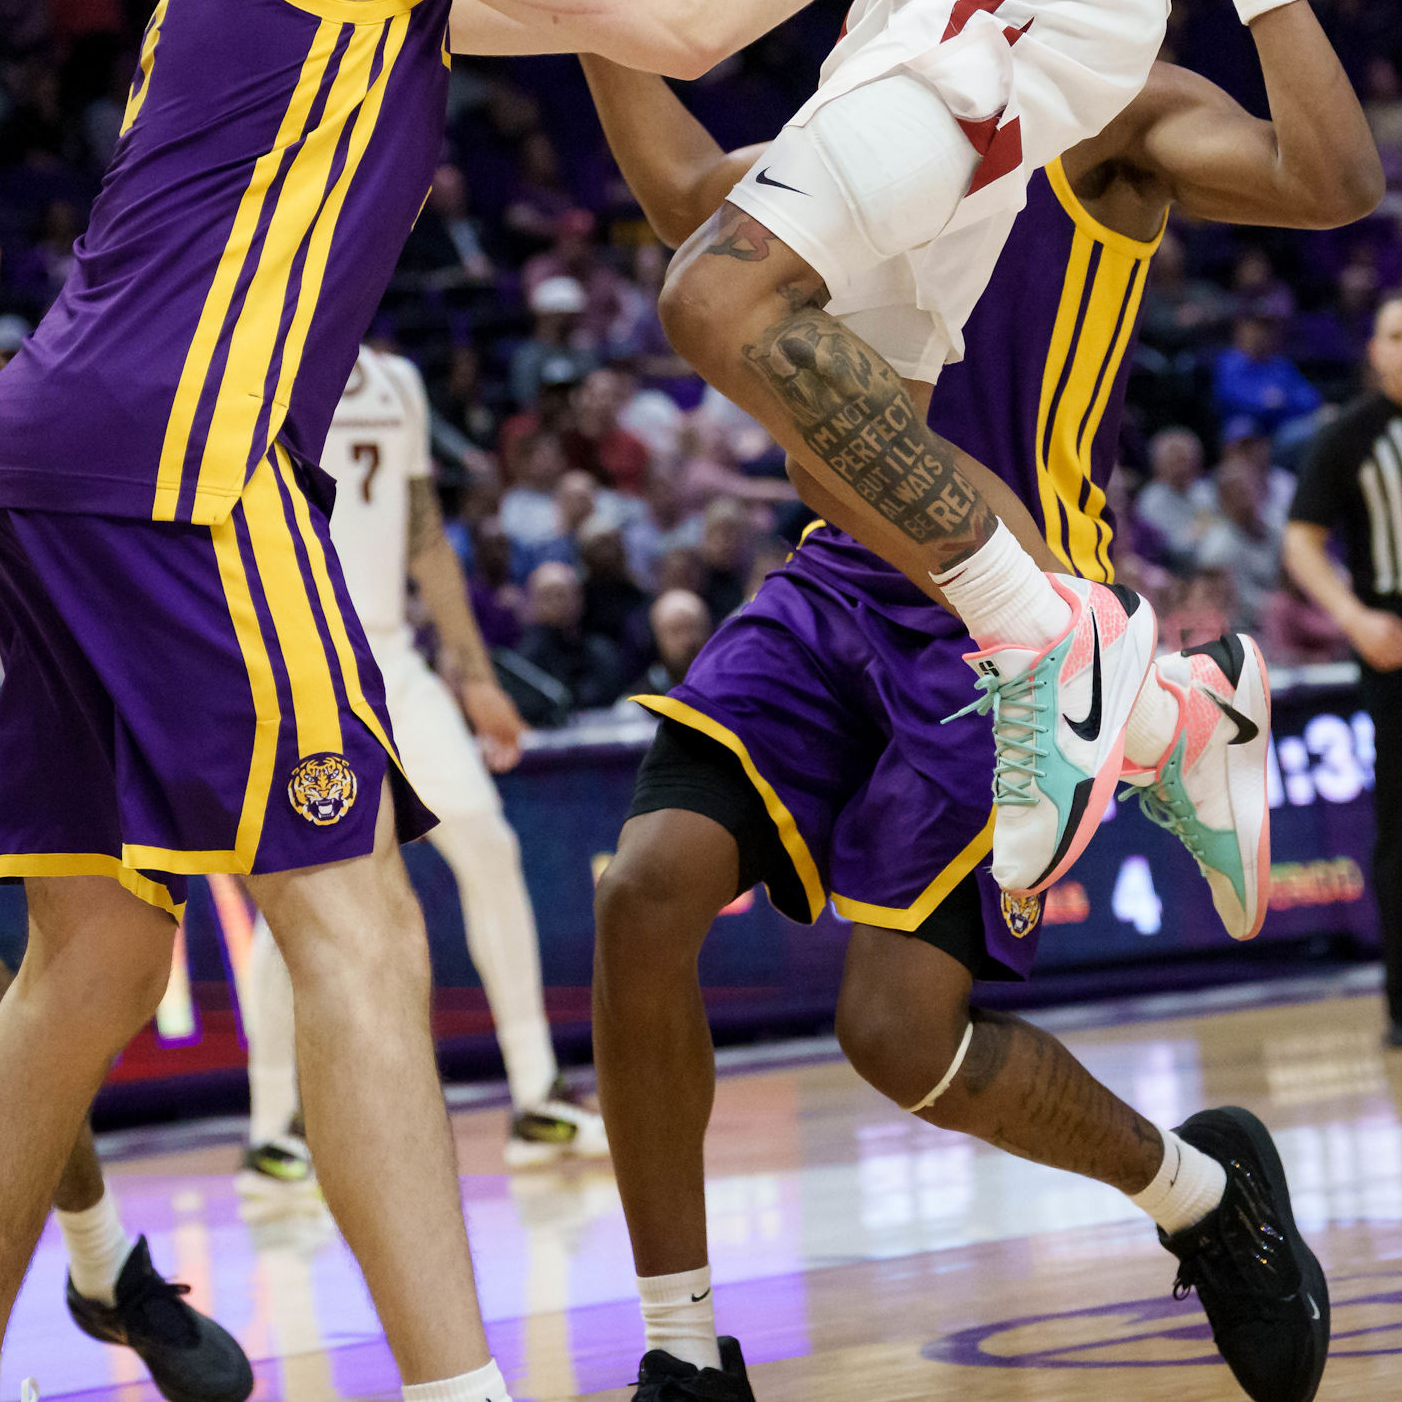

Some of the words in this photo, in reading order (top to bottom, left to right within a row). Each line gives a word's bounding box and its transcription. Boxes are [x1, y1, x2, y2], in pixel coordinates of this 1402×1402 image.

[829, 394, 913, 481] PERFECT
[831, 396, 871, 437] NOT
[350, 441, 382, 504] 7
[857, 466, 892, 502] BUT
[885, 437, 925, 475] ILL
[879, 454, 943, 520] ALWAYS
[904, 514, 936, 539] BE
[1111, 855, 1164, 936] 4
